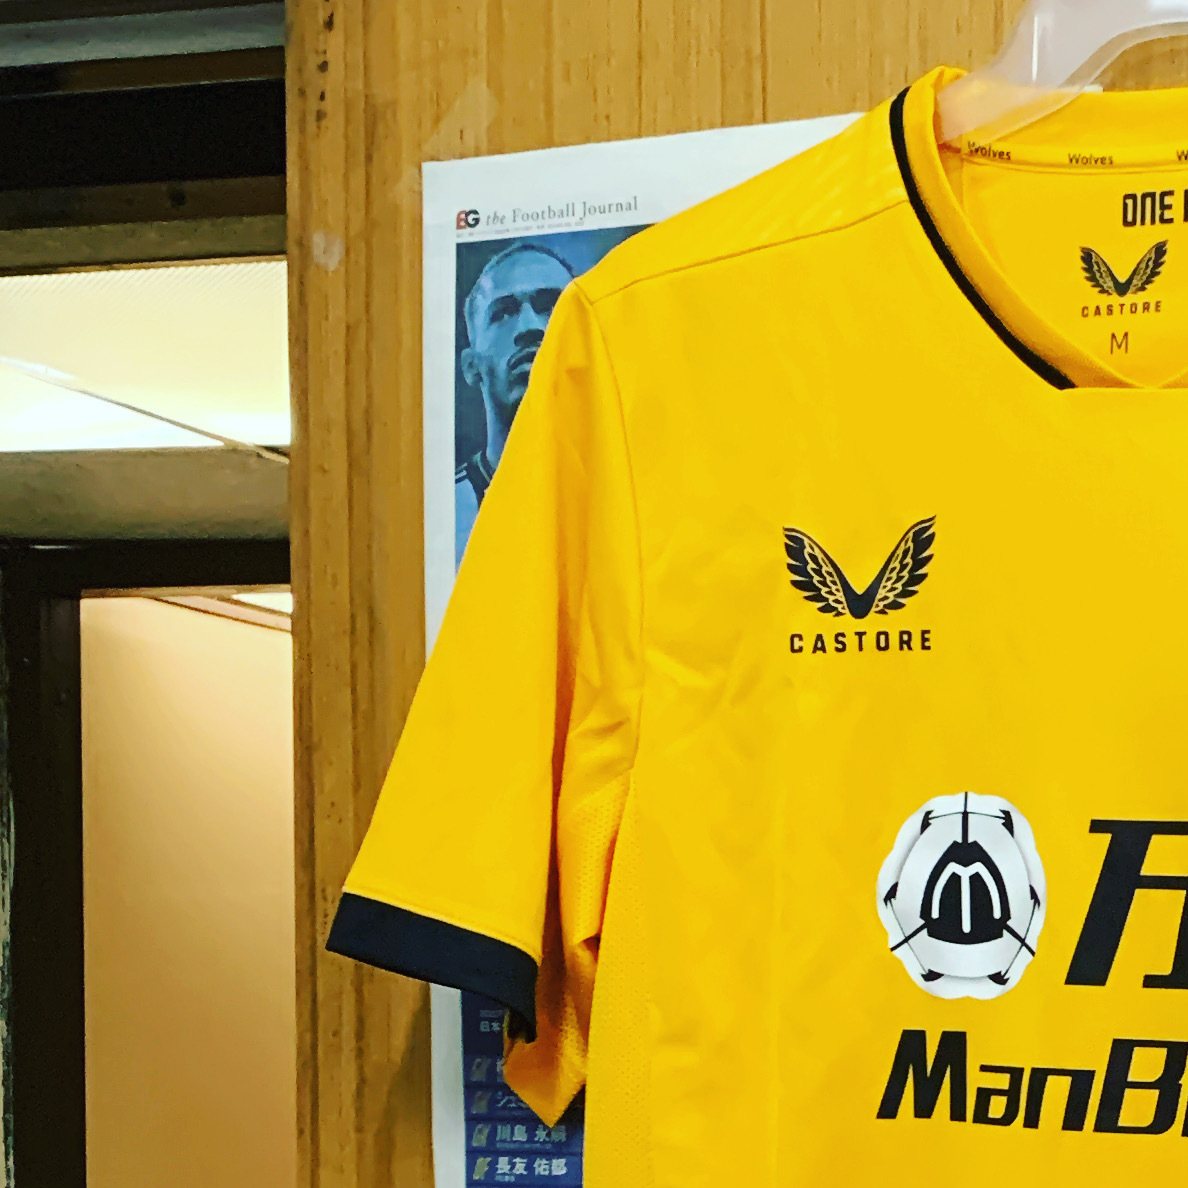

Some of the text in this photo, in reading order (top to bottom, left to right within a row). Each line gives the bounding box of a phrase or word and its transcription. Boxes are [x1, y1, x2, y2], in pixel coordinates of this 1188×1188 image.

[1068, 152, 1114, 166] Wolves
[486, 210, 506, 226] the
[511, 202, 576, 223] Football
[579, 195, 638, 221] Journal
[1122, 190, 1175, 227] ONE
[1081, 300, 1162, 318] CASTORE
[1110, 331, 1129, 355] M
[789, 627, 932, 657] CASTORE
[495, 1156, 528, 1175] 長友
